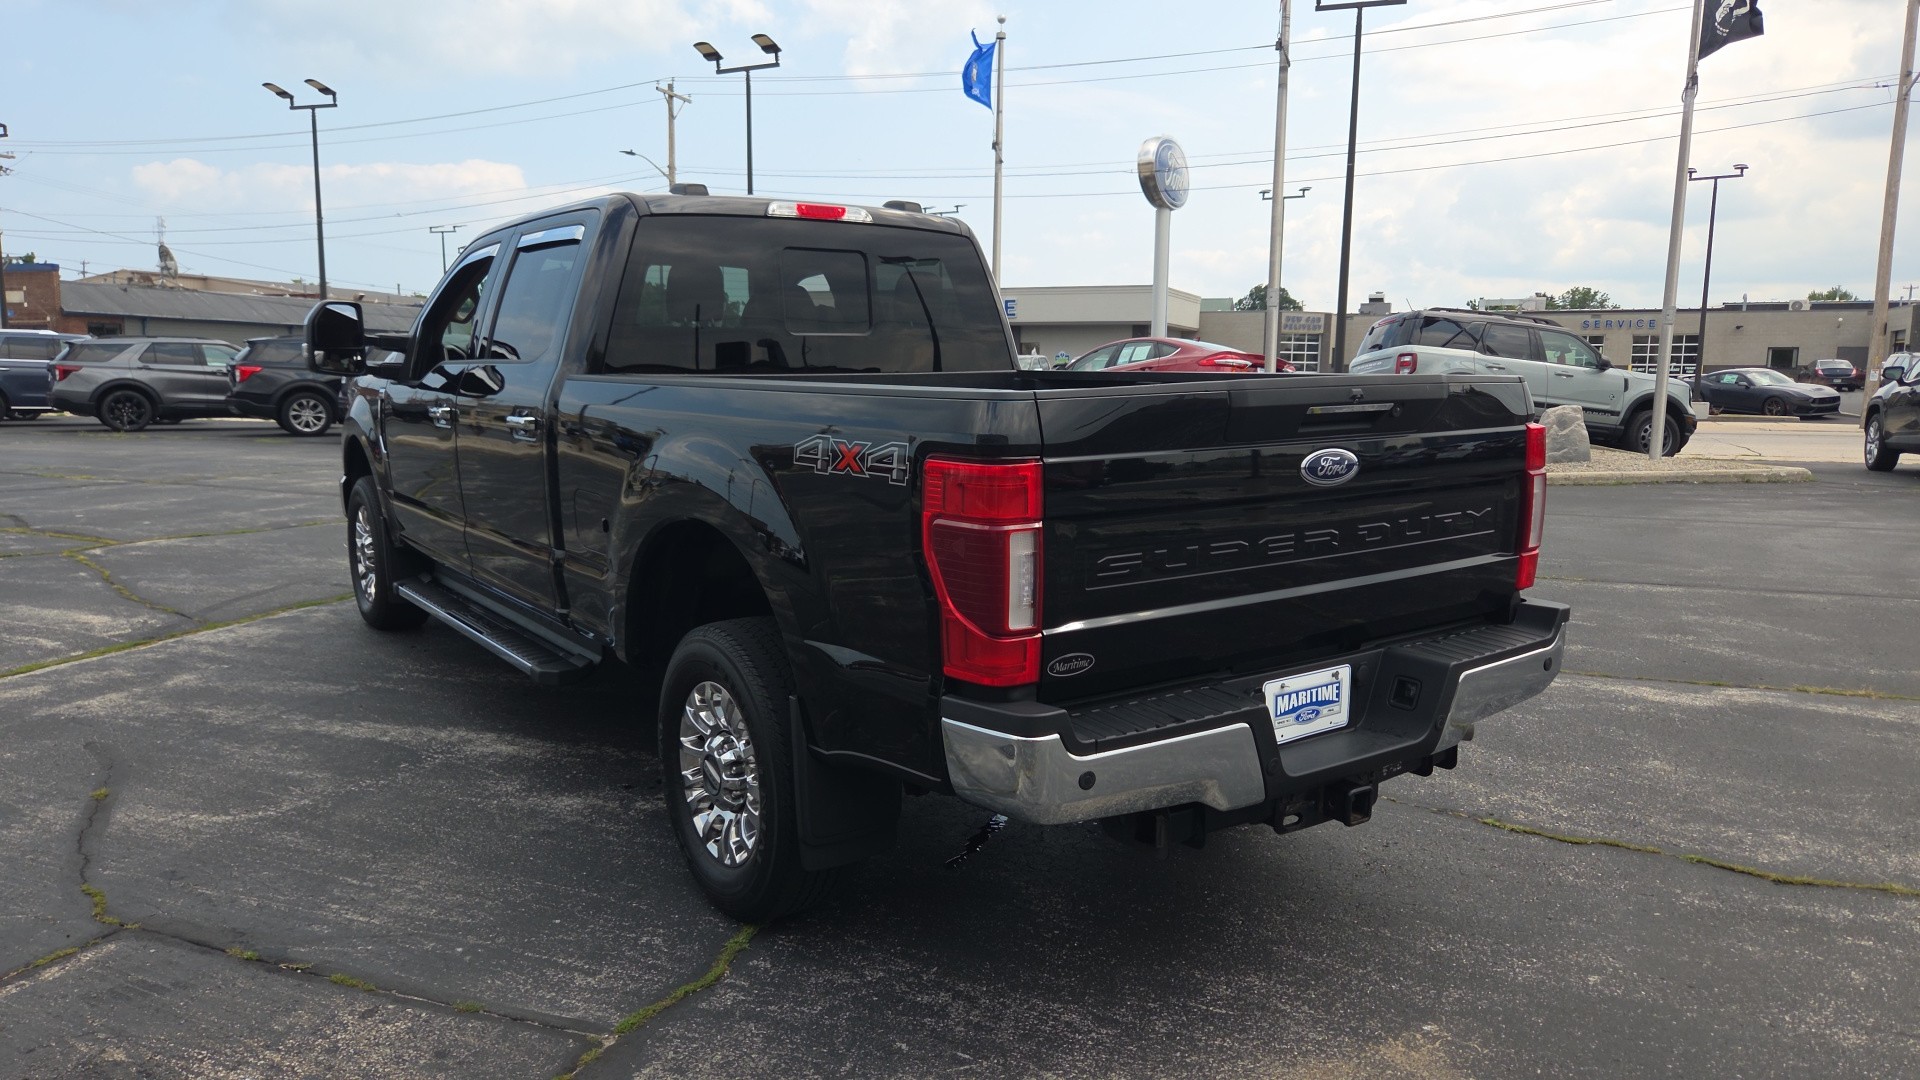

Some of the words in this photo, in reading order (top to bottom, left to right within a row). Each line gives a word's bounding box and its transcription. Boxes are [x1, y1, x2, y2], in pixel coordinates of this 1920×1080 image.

[1582, 319, 1657, 329] SERVICE
[1317, 456, 1348, 476] Ford
[1096, 528, 1340, 577] SUPER
[1357, 507, 1493, 542] DUTY
[1053, 658, 1090, 673] Maritime
[1277, 683, 1340, 716] MARITIME
[1298, 708, 1318, 722] Ford
